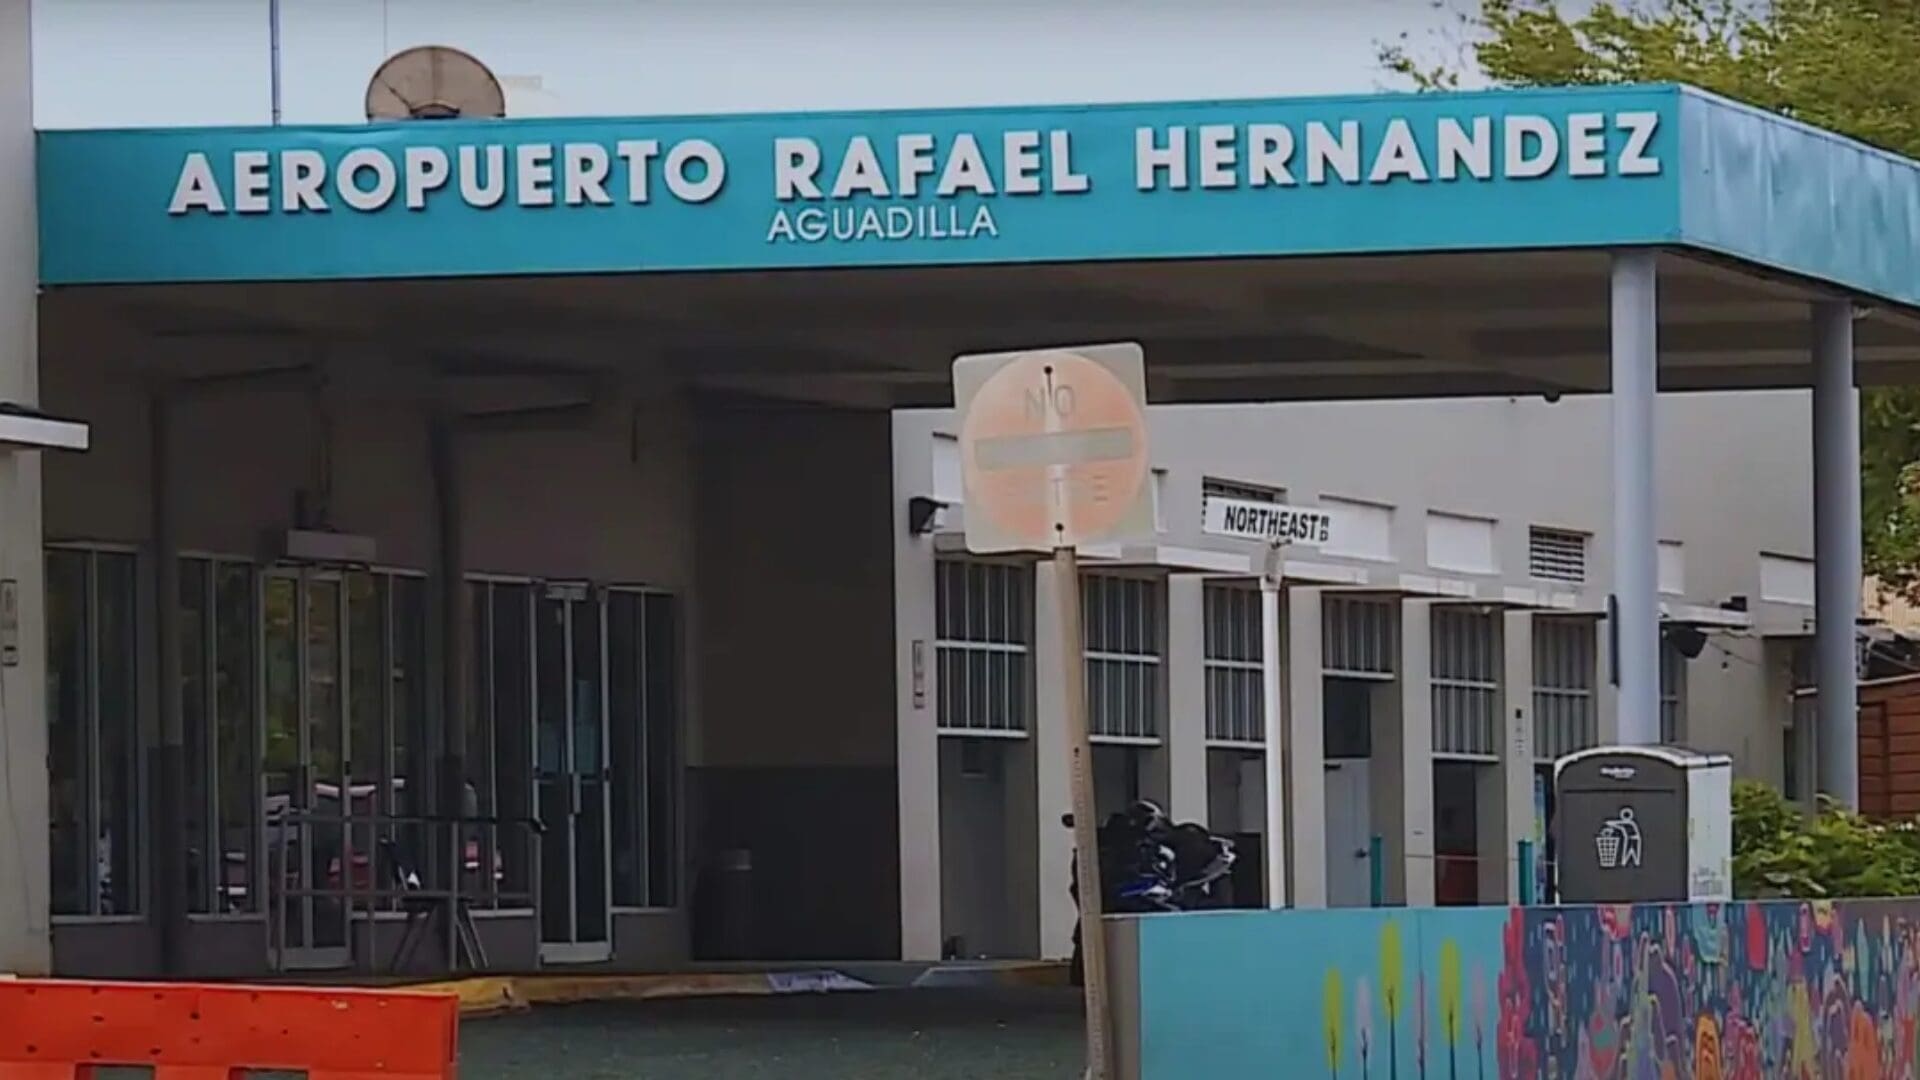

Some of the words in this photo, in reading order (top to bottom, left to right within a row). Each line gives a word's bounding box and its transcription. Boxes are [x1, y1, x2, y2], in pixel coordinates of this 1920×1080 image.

[168, 139, 727, 215] AEROPUERTO
[774, 129, 1089, 199] RAFAEL
[1135, 111, 1661, 190] HERNANDEZ
[767, 205, 999, 242] AGUADILLA
[1024, 384, 1075, 419] NO
[1224, 505, 1319, 540] NORTHEAST
